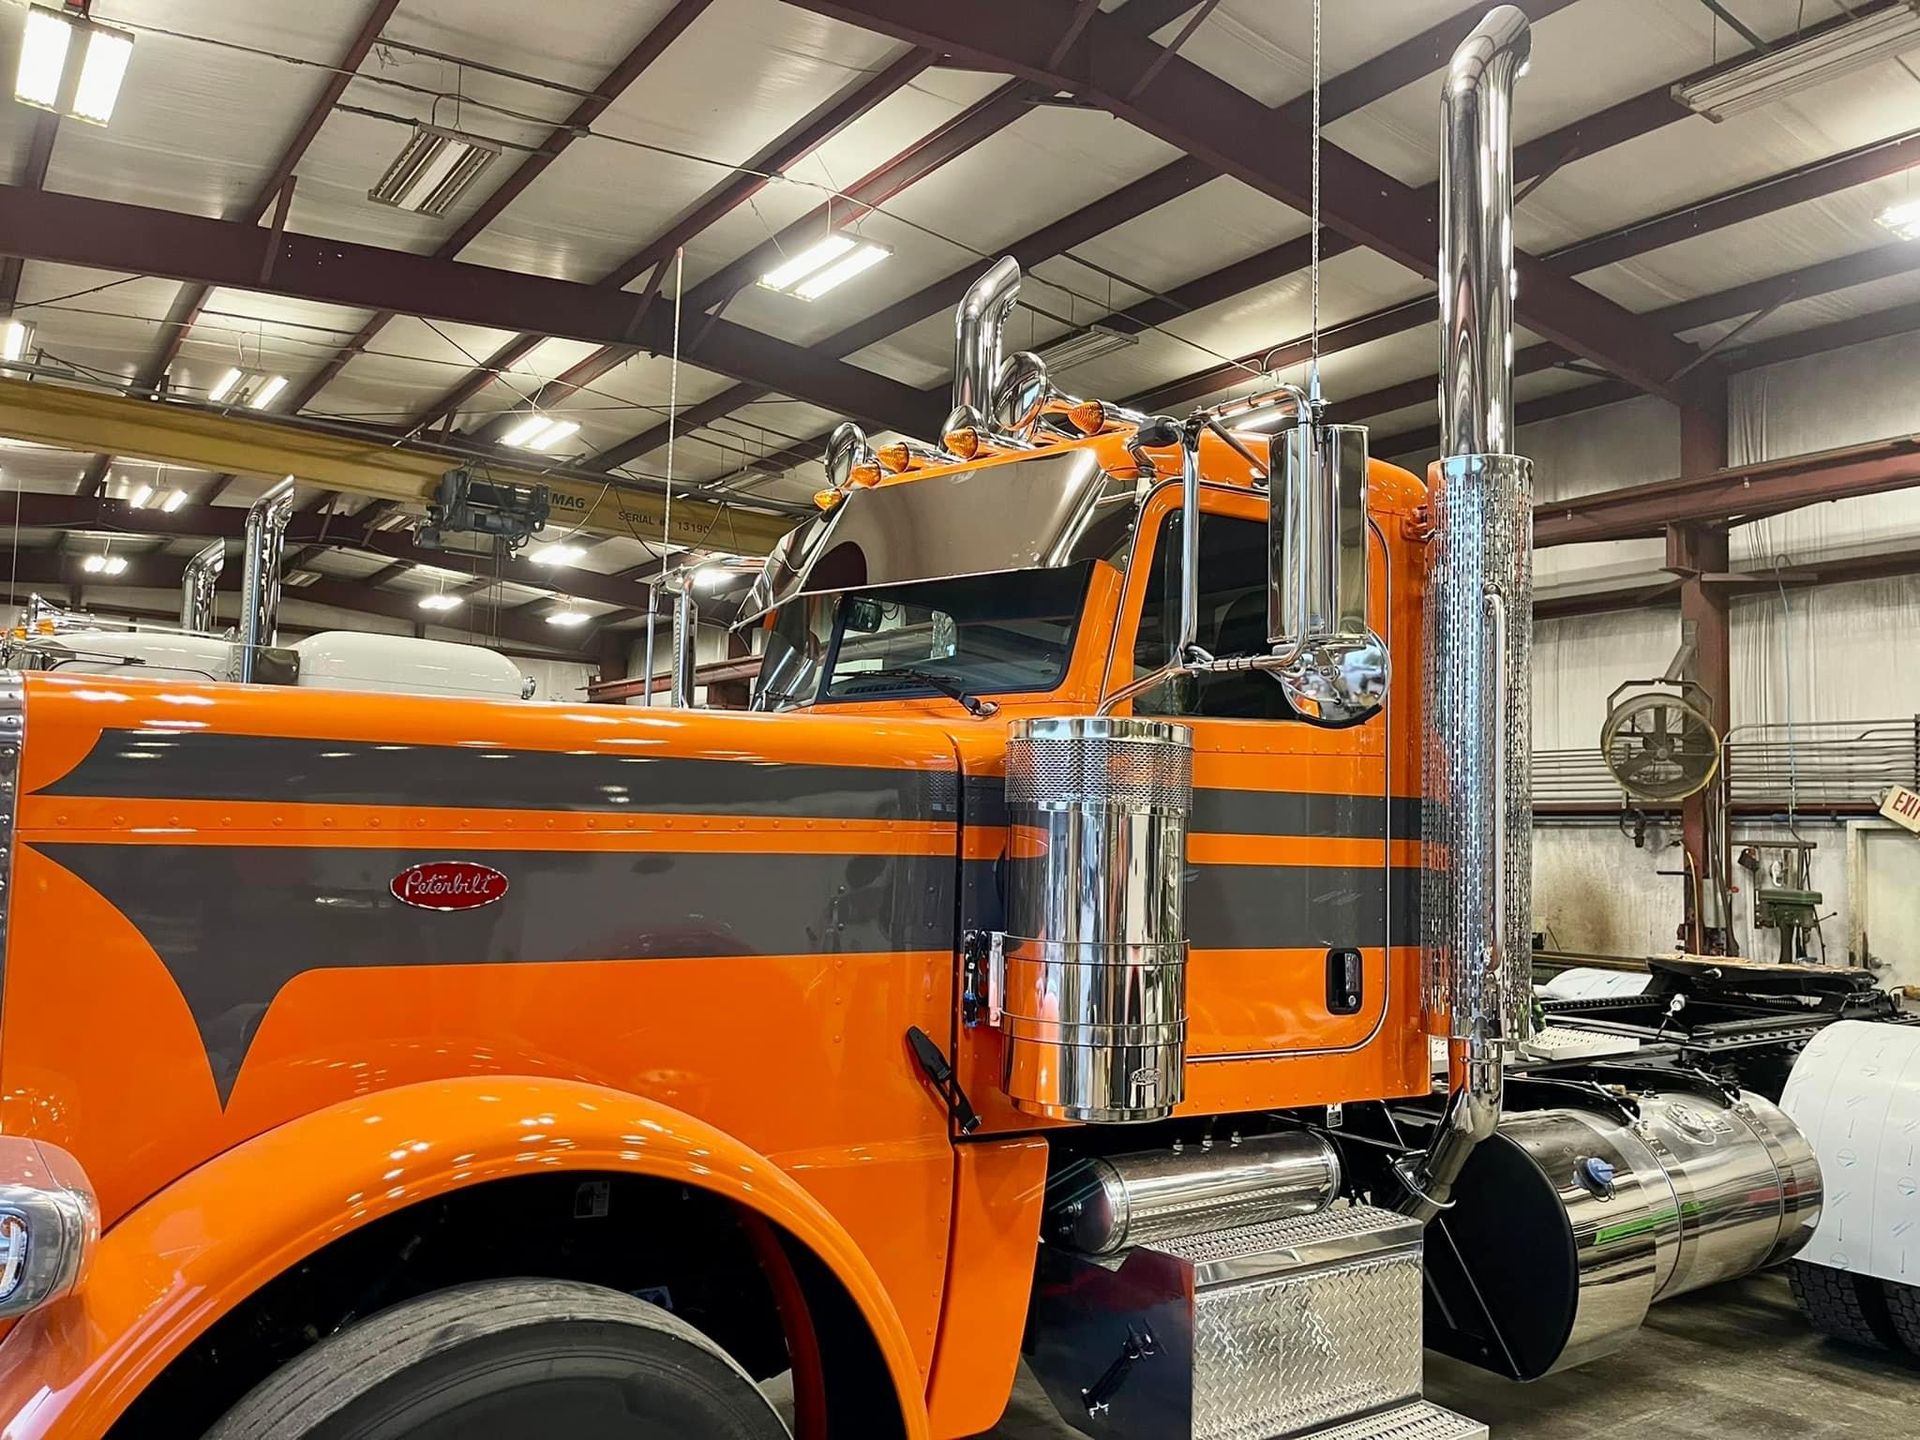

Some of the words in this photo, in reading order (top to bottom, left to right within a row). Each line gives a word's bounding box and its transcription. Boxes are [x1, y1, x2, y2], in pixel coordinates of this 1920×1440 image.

[550, 492, 586, 509] MAG
[618, 511, 656, 526] SERIAL
[404, 870, 500, 898] Peterbilt
